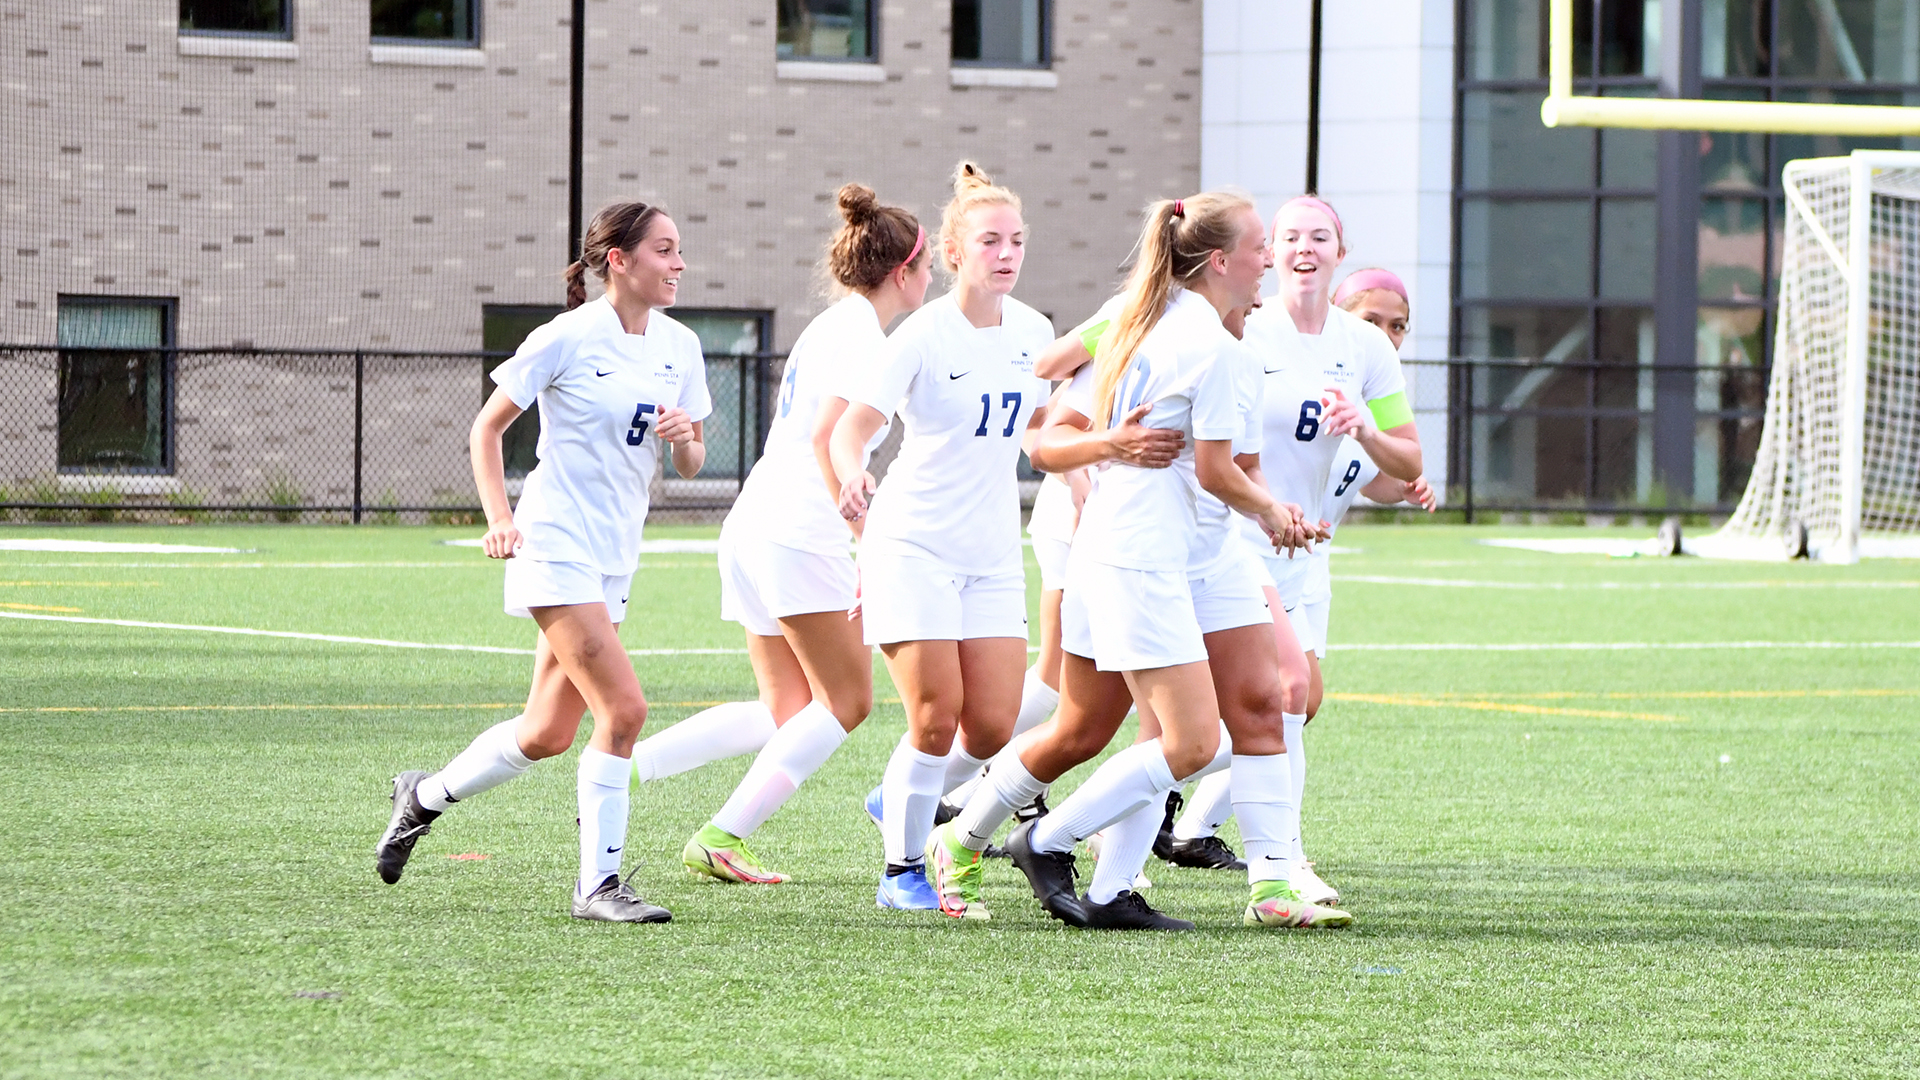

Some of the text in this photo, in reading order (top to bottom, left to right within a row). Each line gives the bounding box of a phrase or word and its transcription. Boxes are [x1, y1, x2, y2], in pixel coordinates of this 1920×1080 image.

[626, 402, 656, 446] 5
[974, 392, 1022, 438] 17
[1295, 400, 1322, 442] 6
[1334, 459, 1361, 497] 9
